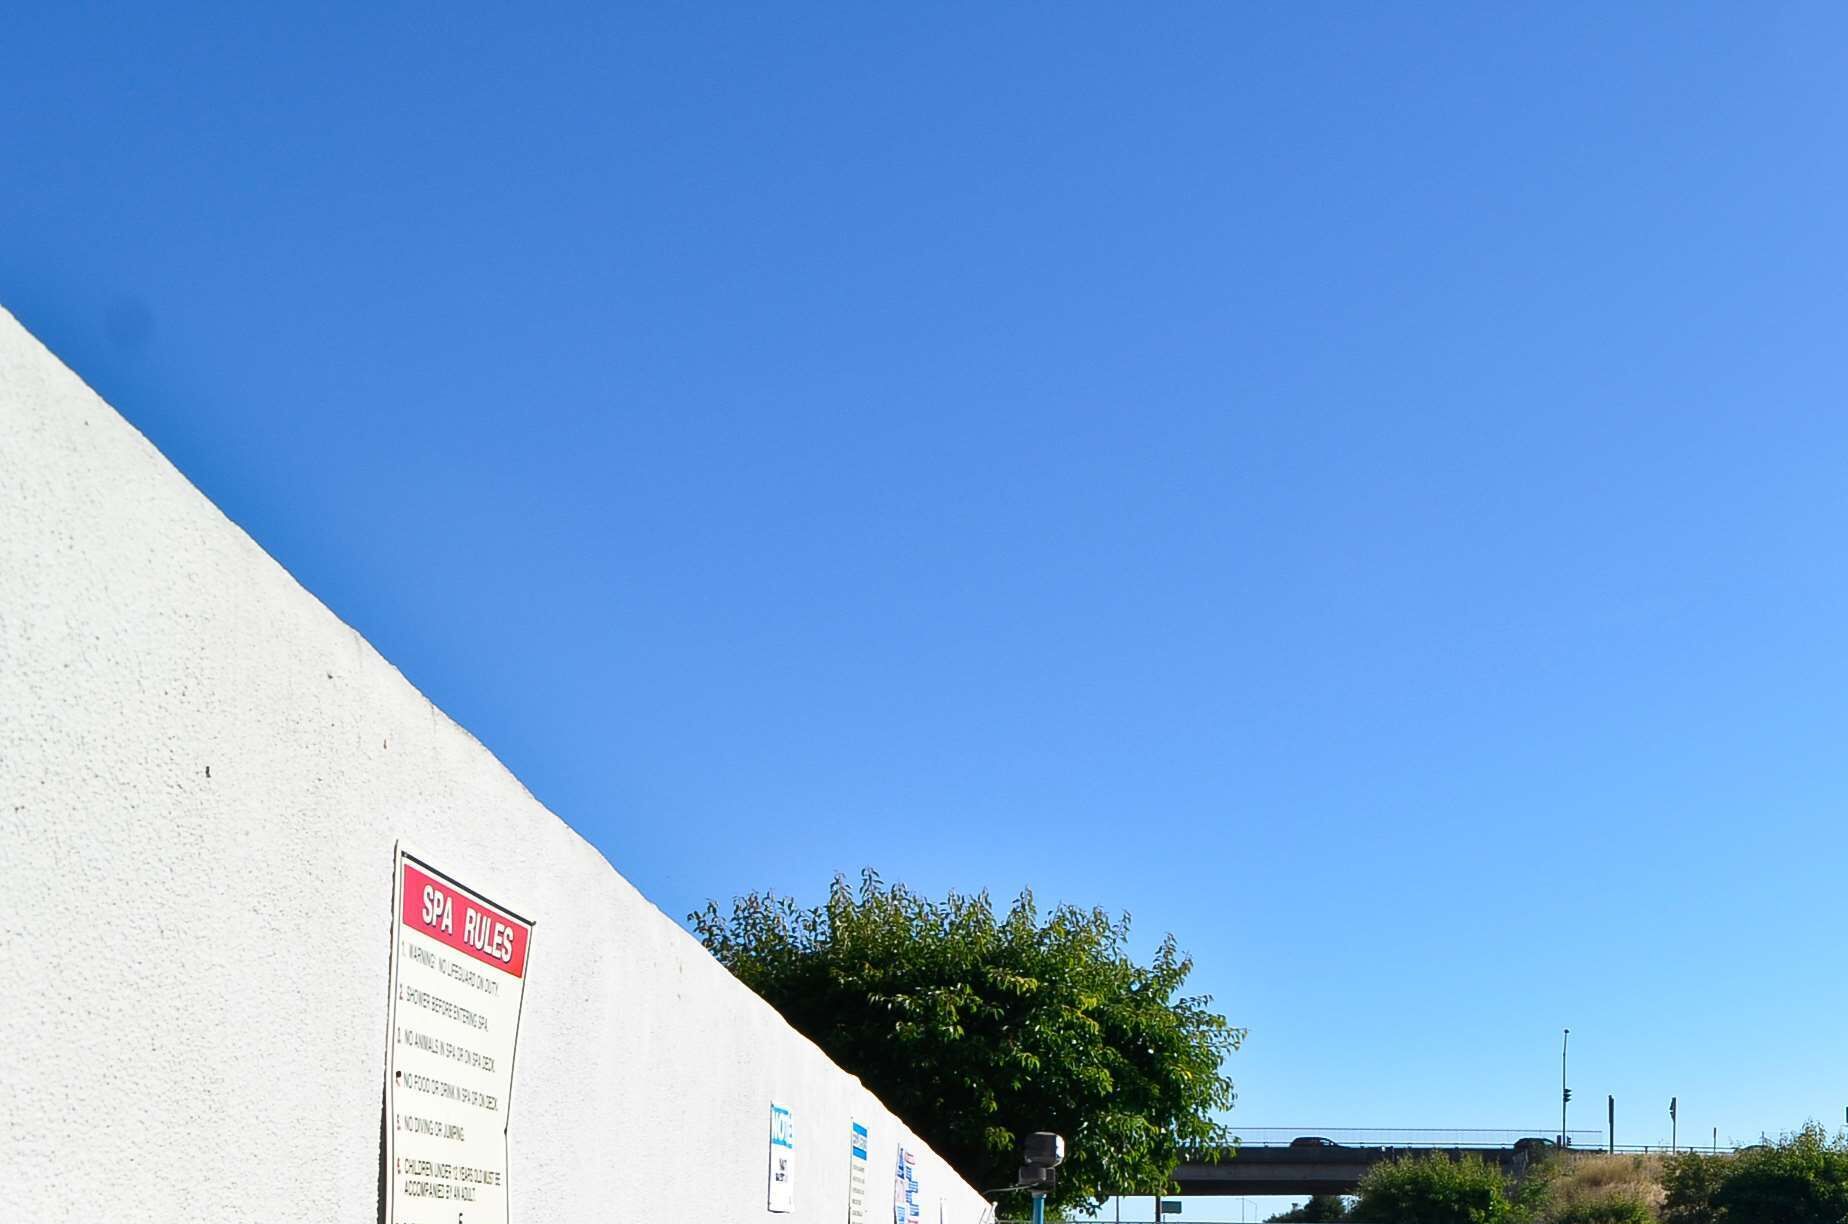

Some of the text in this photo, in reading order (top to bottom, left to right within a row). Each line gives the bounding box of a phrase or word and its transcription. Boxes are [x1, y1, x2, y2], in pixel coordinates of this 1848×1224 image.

[422, 884, 514, 964] SPA RULES
[438, 958, 446, 974] NO
[448, 963, 475, 988] LIFEGUARD
[476, 975, 484, 990] ON
[406, 985, 431, 1009] SHOWER
[431, 996, 453, 1018] BEFORE
[453, 1004, 478, 1028] ENTERING
[405, 1029, 413, 1046] NO
[415, 1032, 439, 1054] ANIMALS
[446, 1042, 456, 1059] SPA
[472, 1052, 482, 1068] SPA
[403, 1072, 413, 1089] NO
[414, 1074, 430, 1094] FOOD
[440, 1081, 456, 1100] DRINK
[404, 1115, 414, 1132] NO
[414, 1117, 434, 1136] DIVING
[404, 1158, 434, 1177] CHILDREN
[434, 1162, 452, 1180] UNDER
[459, 1166, 475, 1183] YEARS
[474, 1168, 483, 1184] OLD
[483, 1170, 495, 1185] MUST
[404, 1180, 445, 1199] ACCOMPANIED
[445, 1184, 453, 1200] BY
